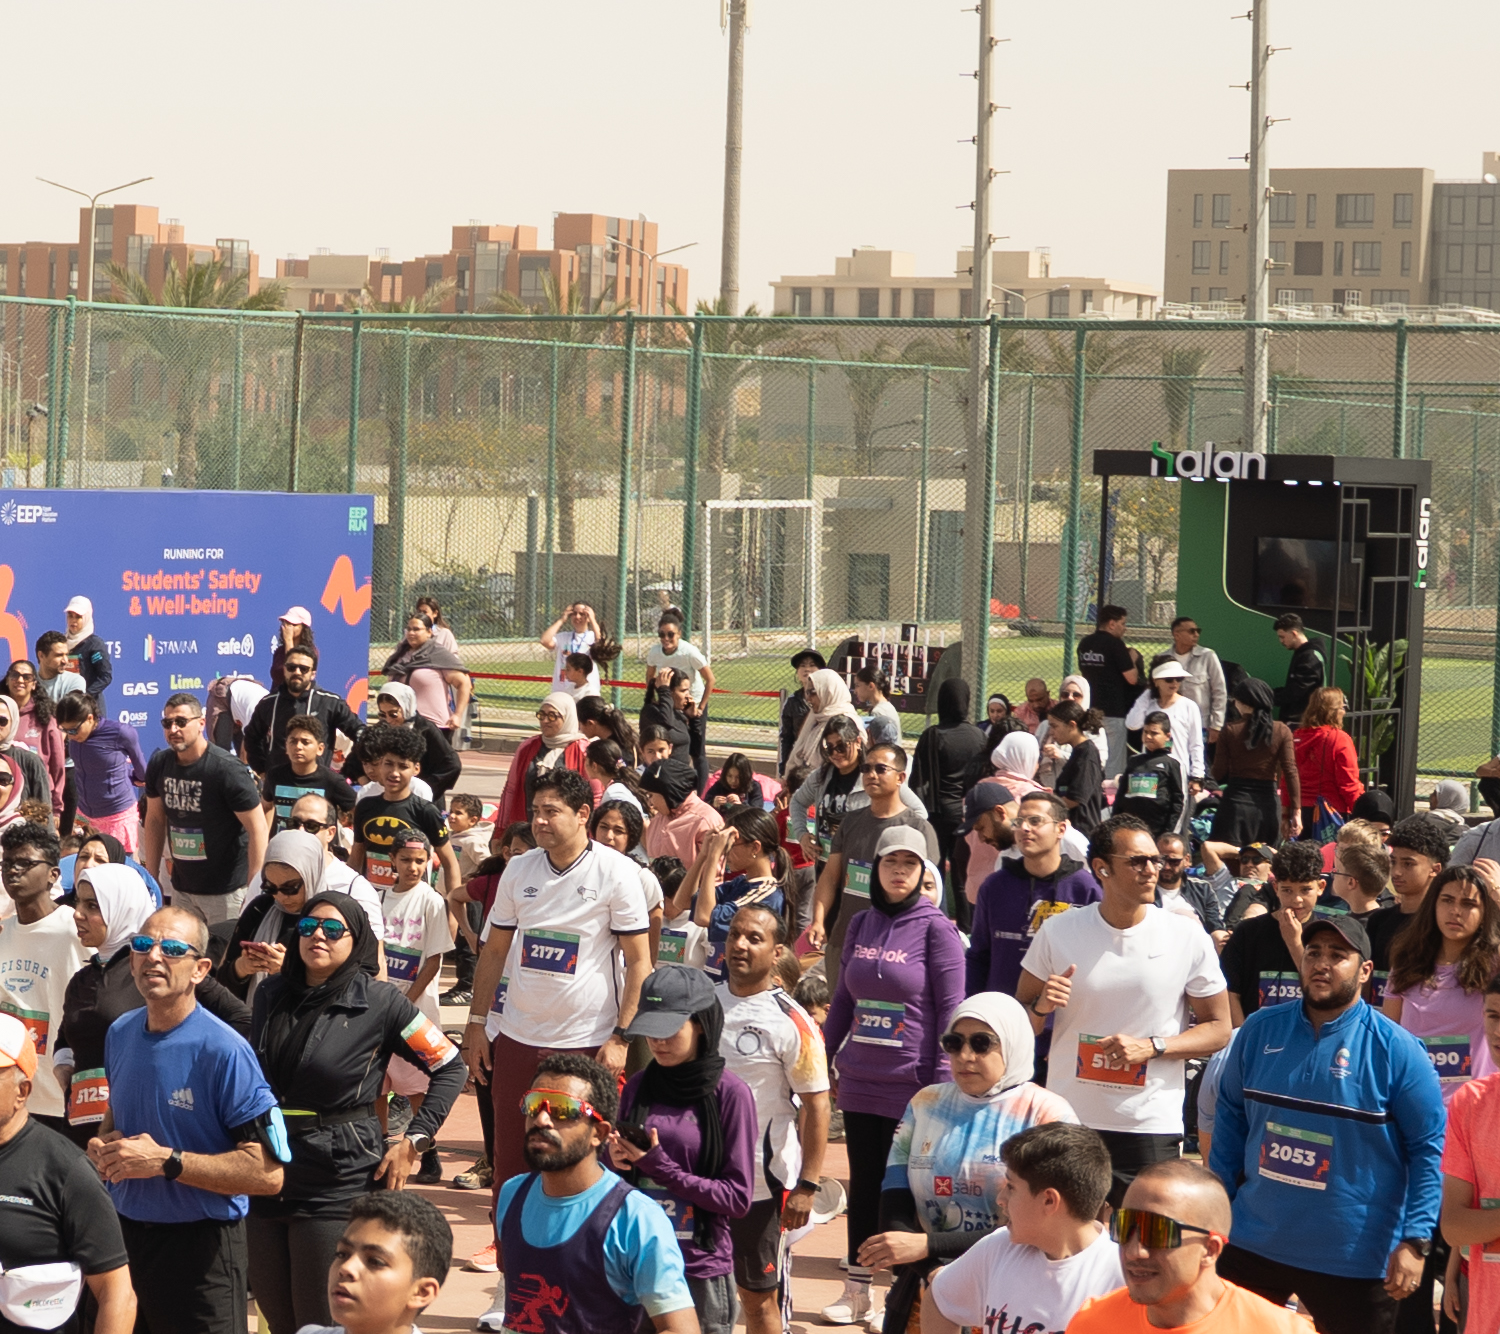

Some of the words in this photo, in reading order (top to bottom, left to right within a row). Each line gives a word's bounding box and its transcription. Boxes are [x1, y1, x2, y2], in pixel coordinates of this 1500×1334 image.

[1151, 441, 1266, 481] halan
[17, 505, 42, 524] EEP
[349, 507, 368, 519] EEP
[348, 519, 368, 532] RUN
[1415, 497, 1431, 588] halan
[164, 548, 204, 560] RUNNING
[205, 548, 224, 560] FOR
[122, 569, 204, 591] Students'
[208, 569, 262, 594] Safety
[129, 596, 142, 616] &
[147, 594, 239, 619] Well-being
[217, 637, 242, 656] safe
[122, 682, 159, 696] GAS
[170, 673, 204, 691] Lime.
[173, 838, 197, 851] 1075
[530, 943, 566, 961] 2177
[76, 1085, 110, 1105] 5125
[1268, 1142, 1317, 1167] 2053
